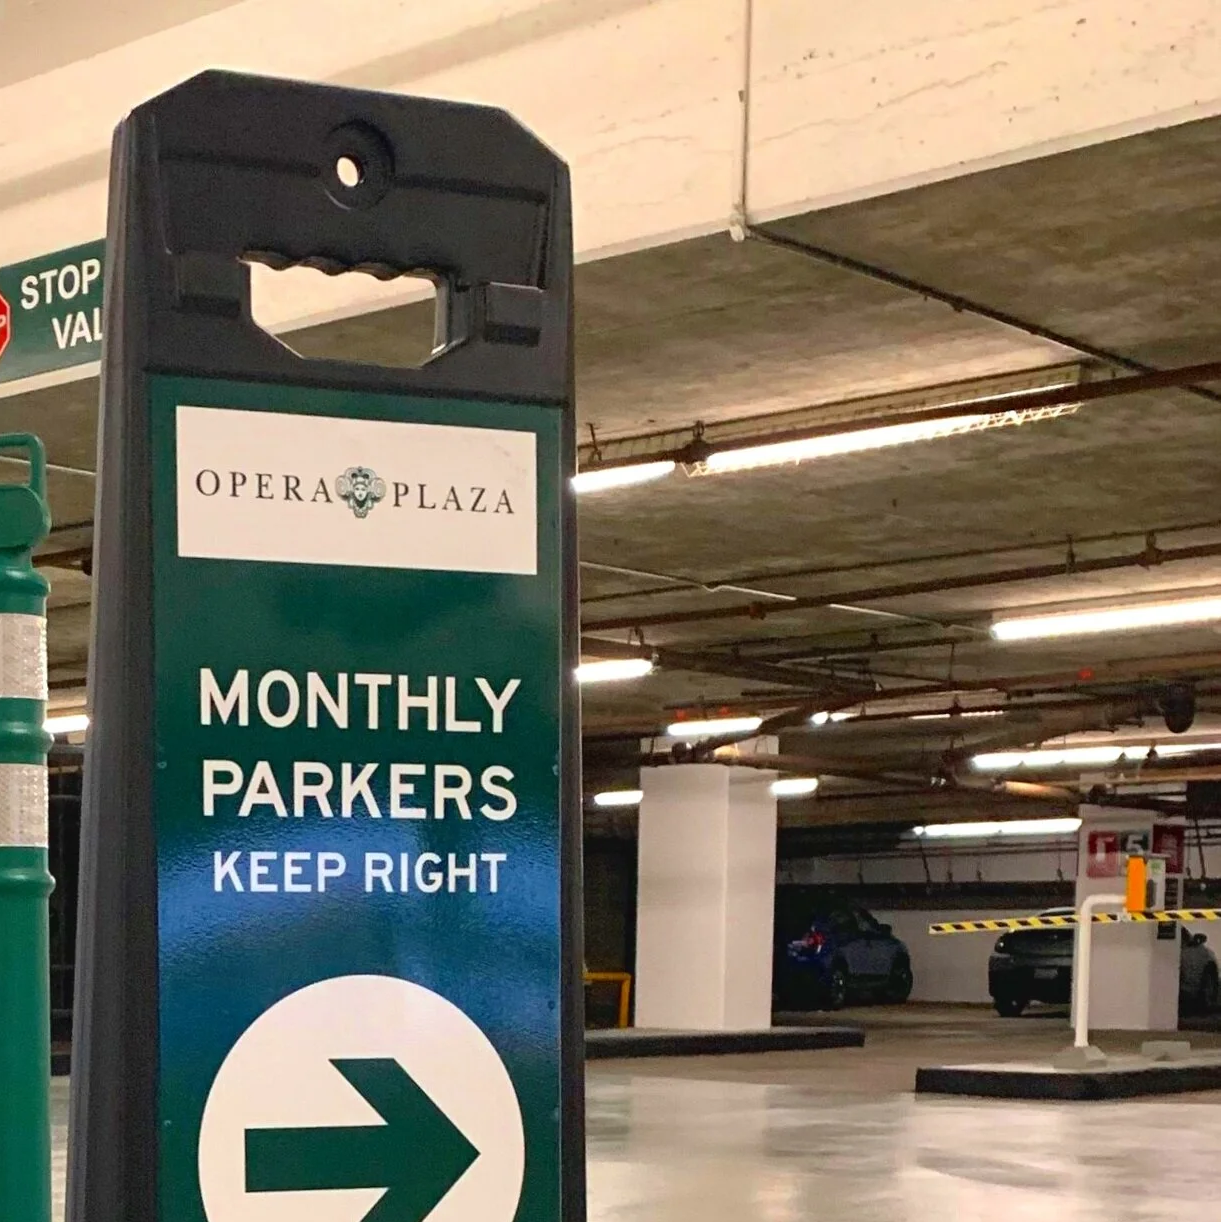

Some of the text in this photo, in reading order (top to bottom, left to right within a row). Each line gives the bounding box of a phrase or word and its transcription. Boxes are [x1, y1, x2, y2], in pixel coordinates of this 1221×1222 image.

[20, 258, 100, 310] STOP
[195, 469, 515, 515] OPERA PLAZA
[199, 667, 522, 733] MONTHLY
[202, 759, 518, 821] PARKERS
[213, 850, 507, 894] KEEP RIGHT
